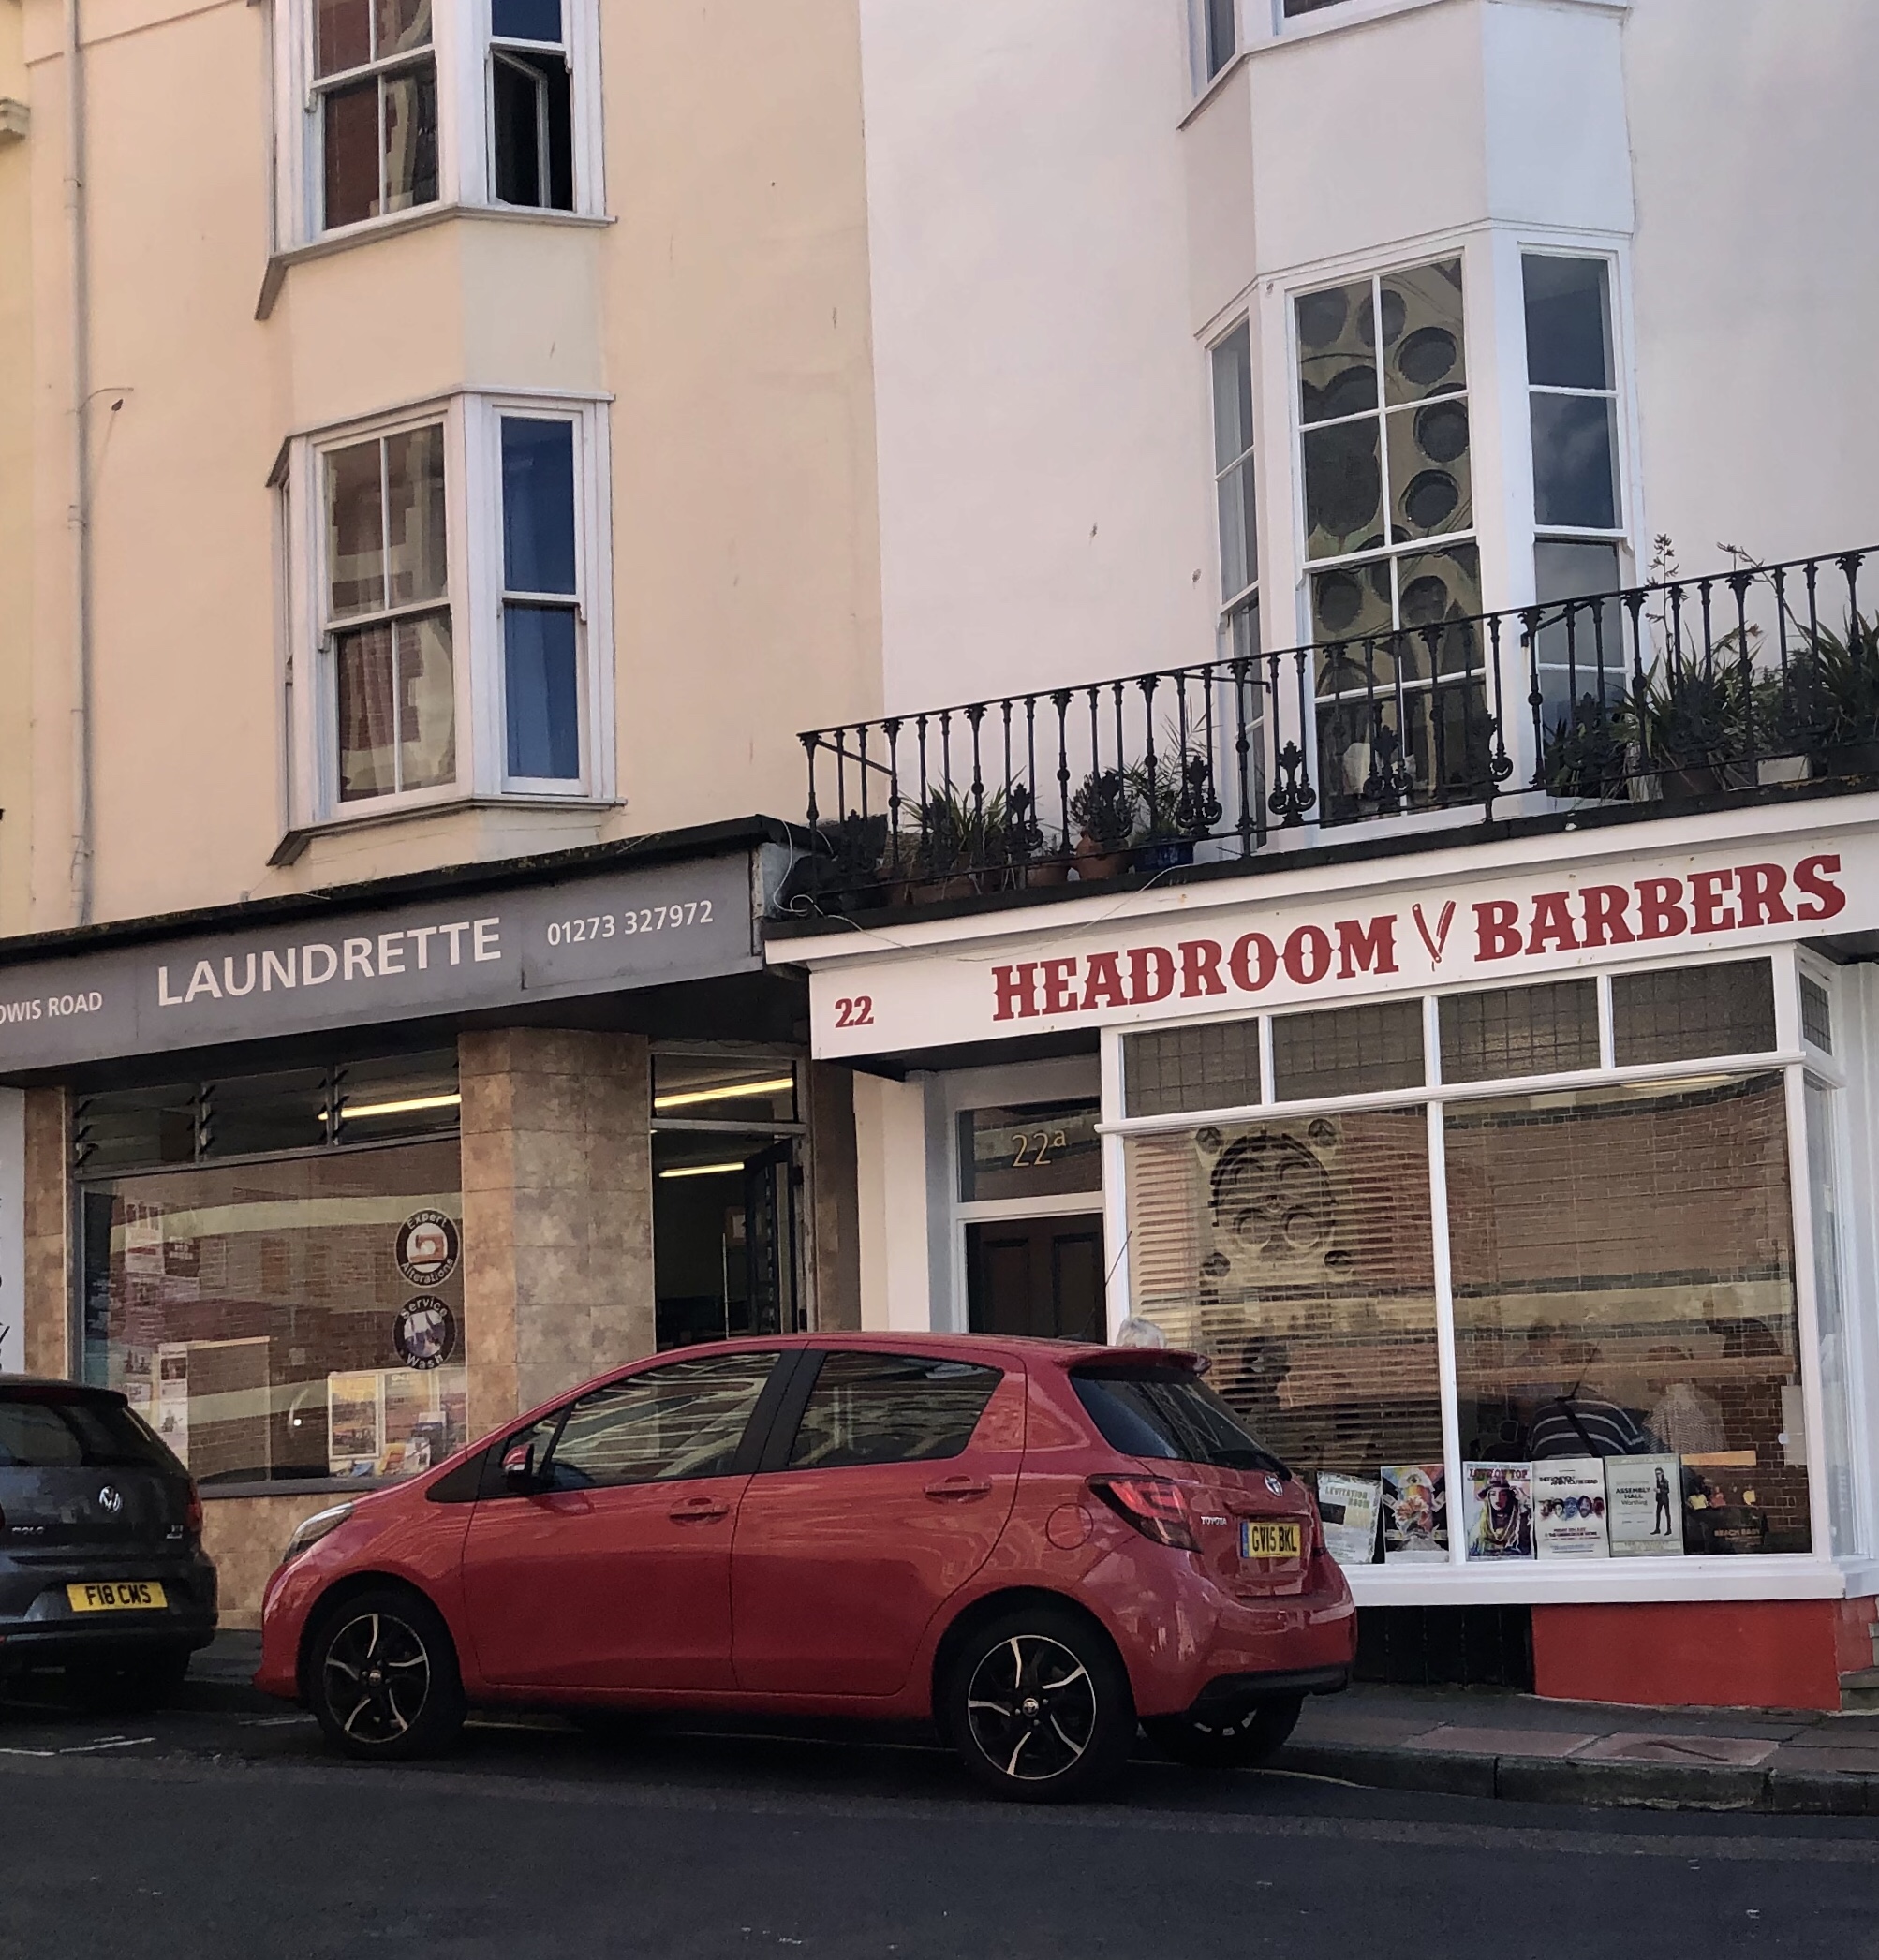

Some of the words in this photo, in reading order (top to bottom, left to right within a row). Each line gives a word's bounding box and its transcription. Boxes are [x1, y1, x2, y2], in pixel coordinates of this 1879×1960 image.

[547, 915, 615, 946] 01273
[624, 900, 714, 935] 327972
[993, 912, 1399, 1021] HEADROOM
[1472, 853, 1847, 962] BARBERS
[157, 917, 502, 1007] LAUNDRETTE
[48, 991, 103, 1018] ROAD
[835, 995, 875, 1028] 22
[1012, 1129, 1067, 1167] 22a
[407, 1212, 448, 1230] Expert
[400, 1258, 454, 1285] Alterations
[400, 1297, 449, 1320] Service
[406, 1352, 444, 1370] Wash
[1279, 1525, 1298, 1553] BKL
[85, 1584, 116, 1606] F18
